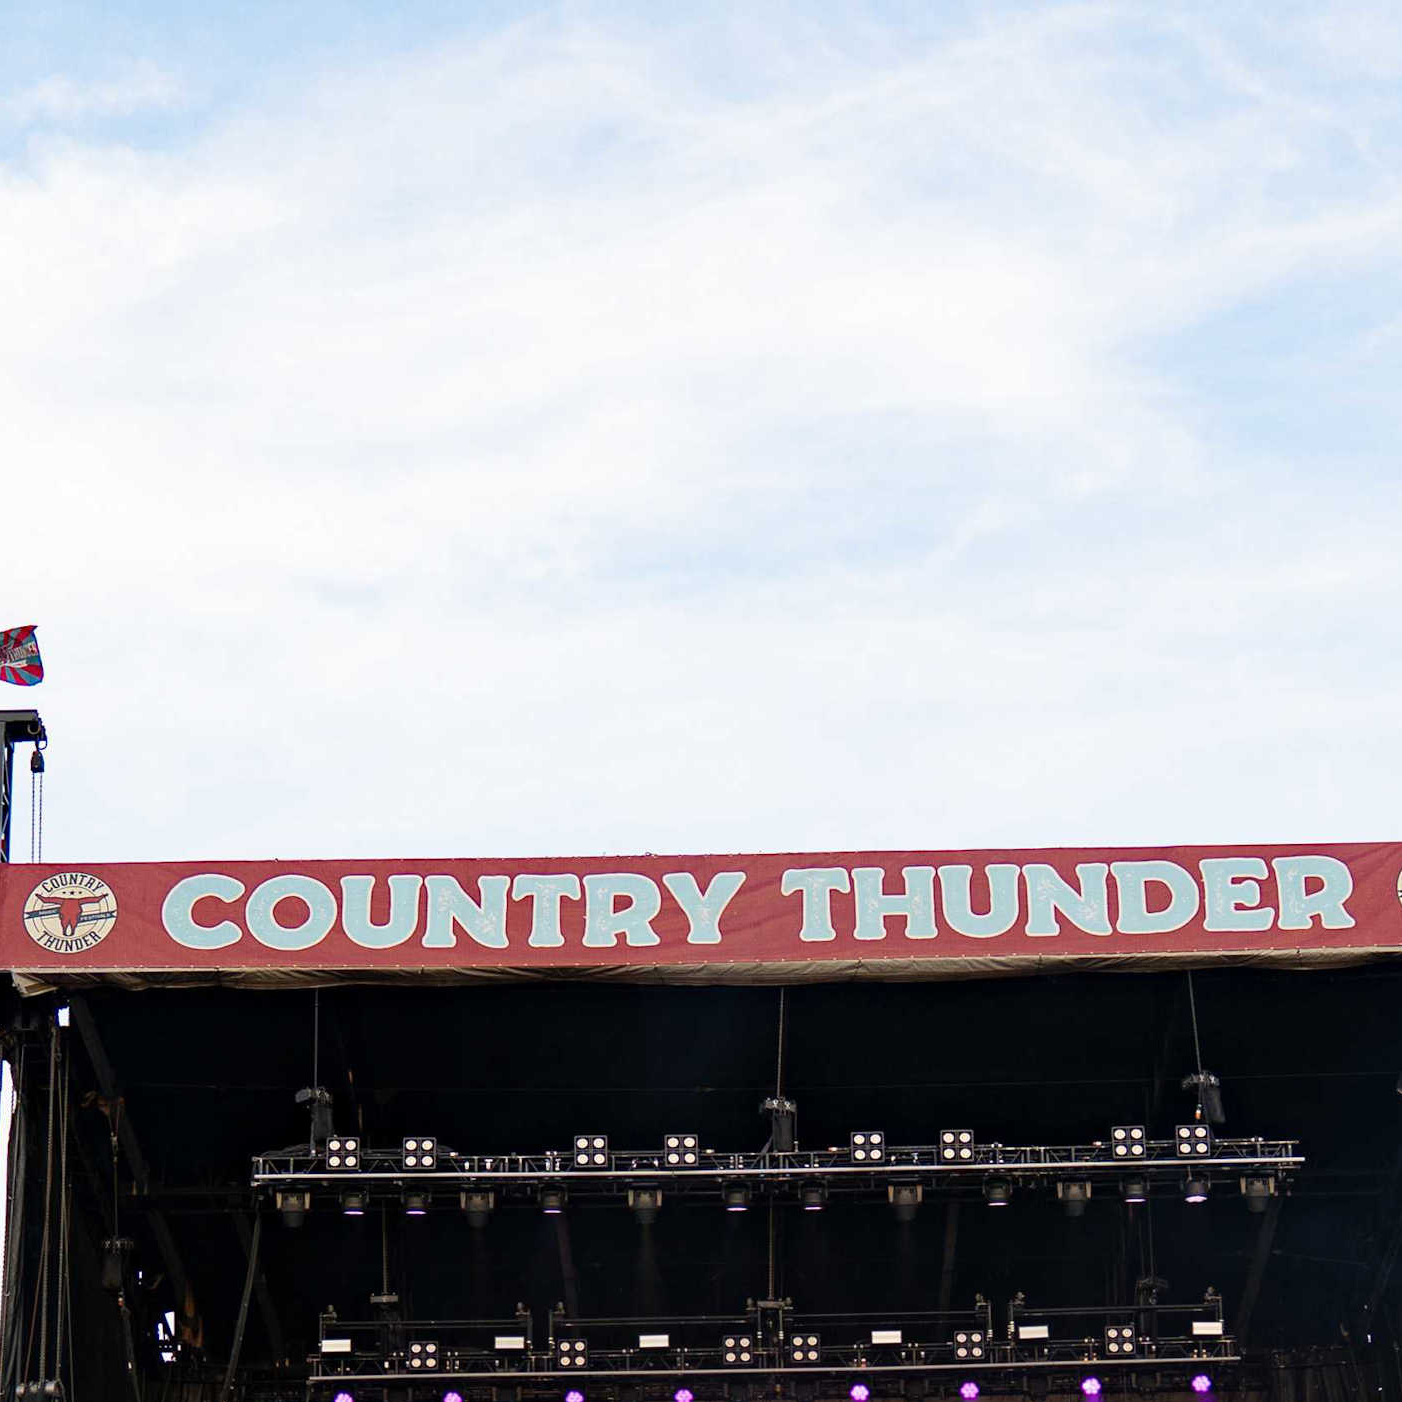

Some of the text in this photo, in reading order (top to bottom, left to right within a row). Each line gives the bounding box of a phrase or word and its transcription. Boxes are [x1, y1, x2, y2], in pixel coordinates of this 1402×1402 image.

[41, 872, 106, 893] COUNTRY
[160, 855, 1356, 951] COUNTRY THUNDER
[37, 930, 102, 953] THUNDER
